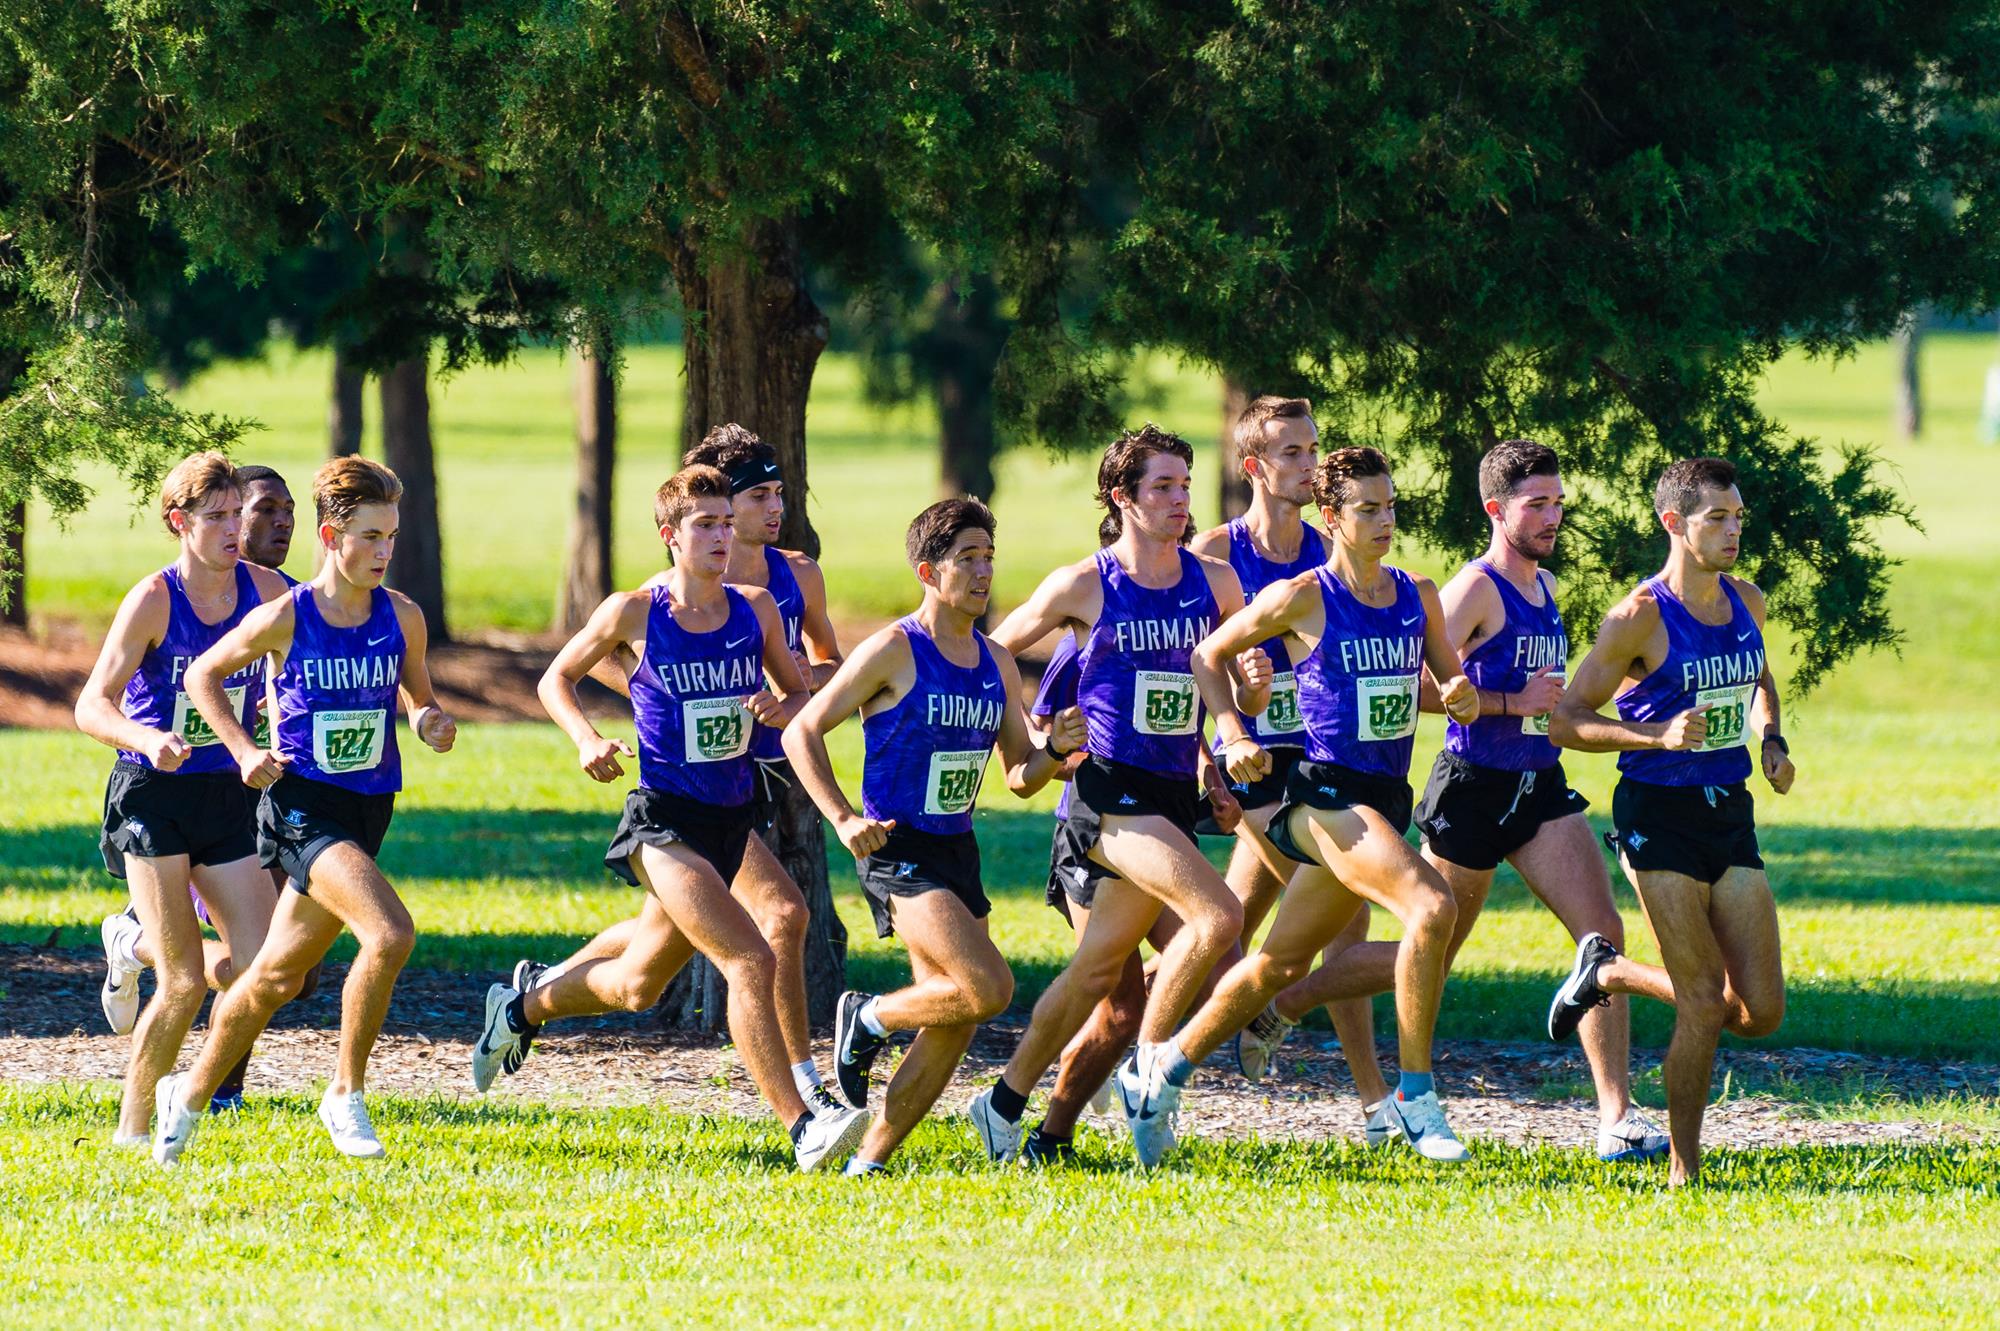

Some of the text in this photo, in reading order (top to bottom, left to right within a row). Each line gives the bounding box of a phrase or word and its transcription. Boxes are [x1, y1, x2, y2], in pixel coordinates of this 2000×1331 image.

[1116, 617, 1210, 652] FURMAN
[303, 655, 398, 690] FURMAN
[658, 655, 756, 694] FURMAN
[1145, 673, 1196, 684] CHARLOT
[1682, 649, 1764, 691] FURMAN
[927, 694, 1003, 731] FURMAN
[1146, 690, 1193, 721] 531
[1267, 688, 1297, 721] 51
[1369, 693, 1413, 726] 522
[1705, 702, 1745, 737] 518
[326, 728, 375, 759] 527
[696, 716, 742, 747] 521
[938, 769, 979, 801] 520
